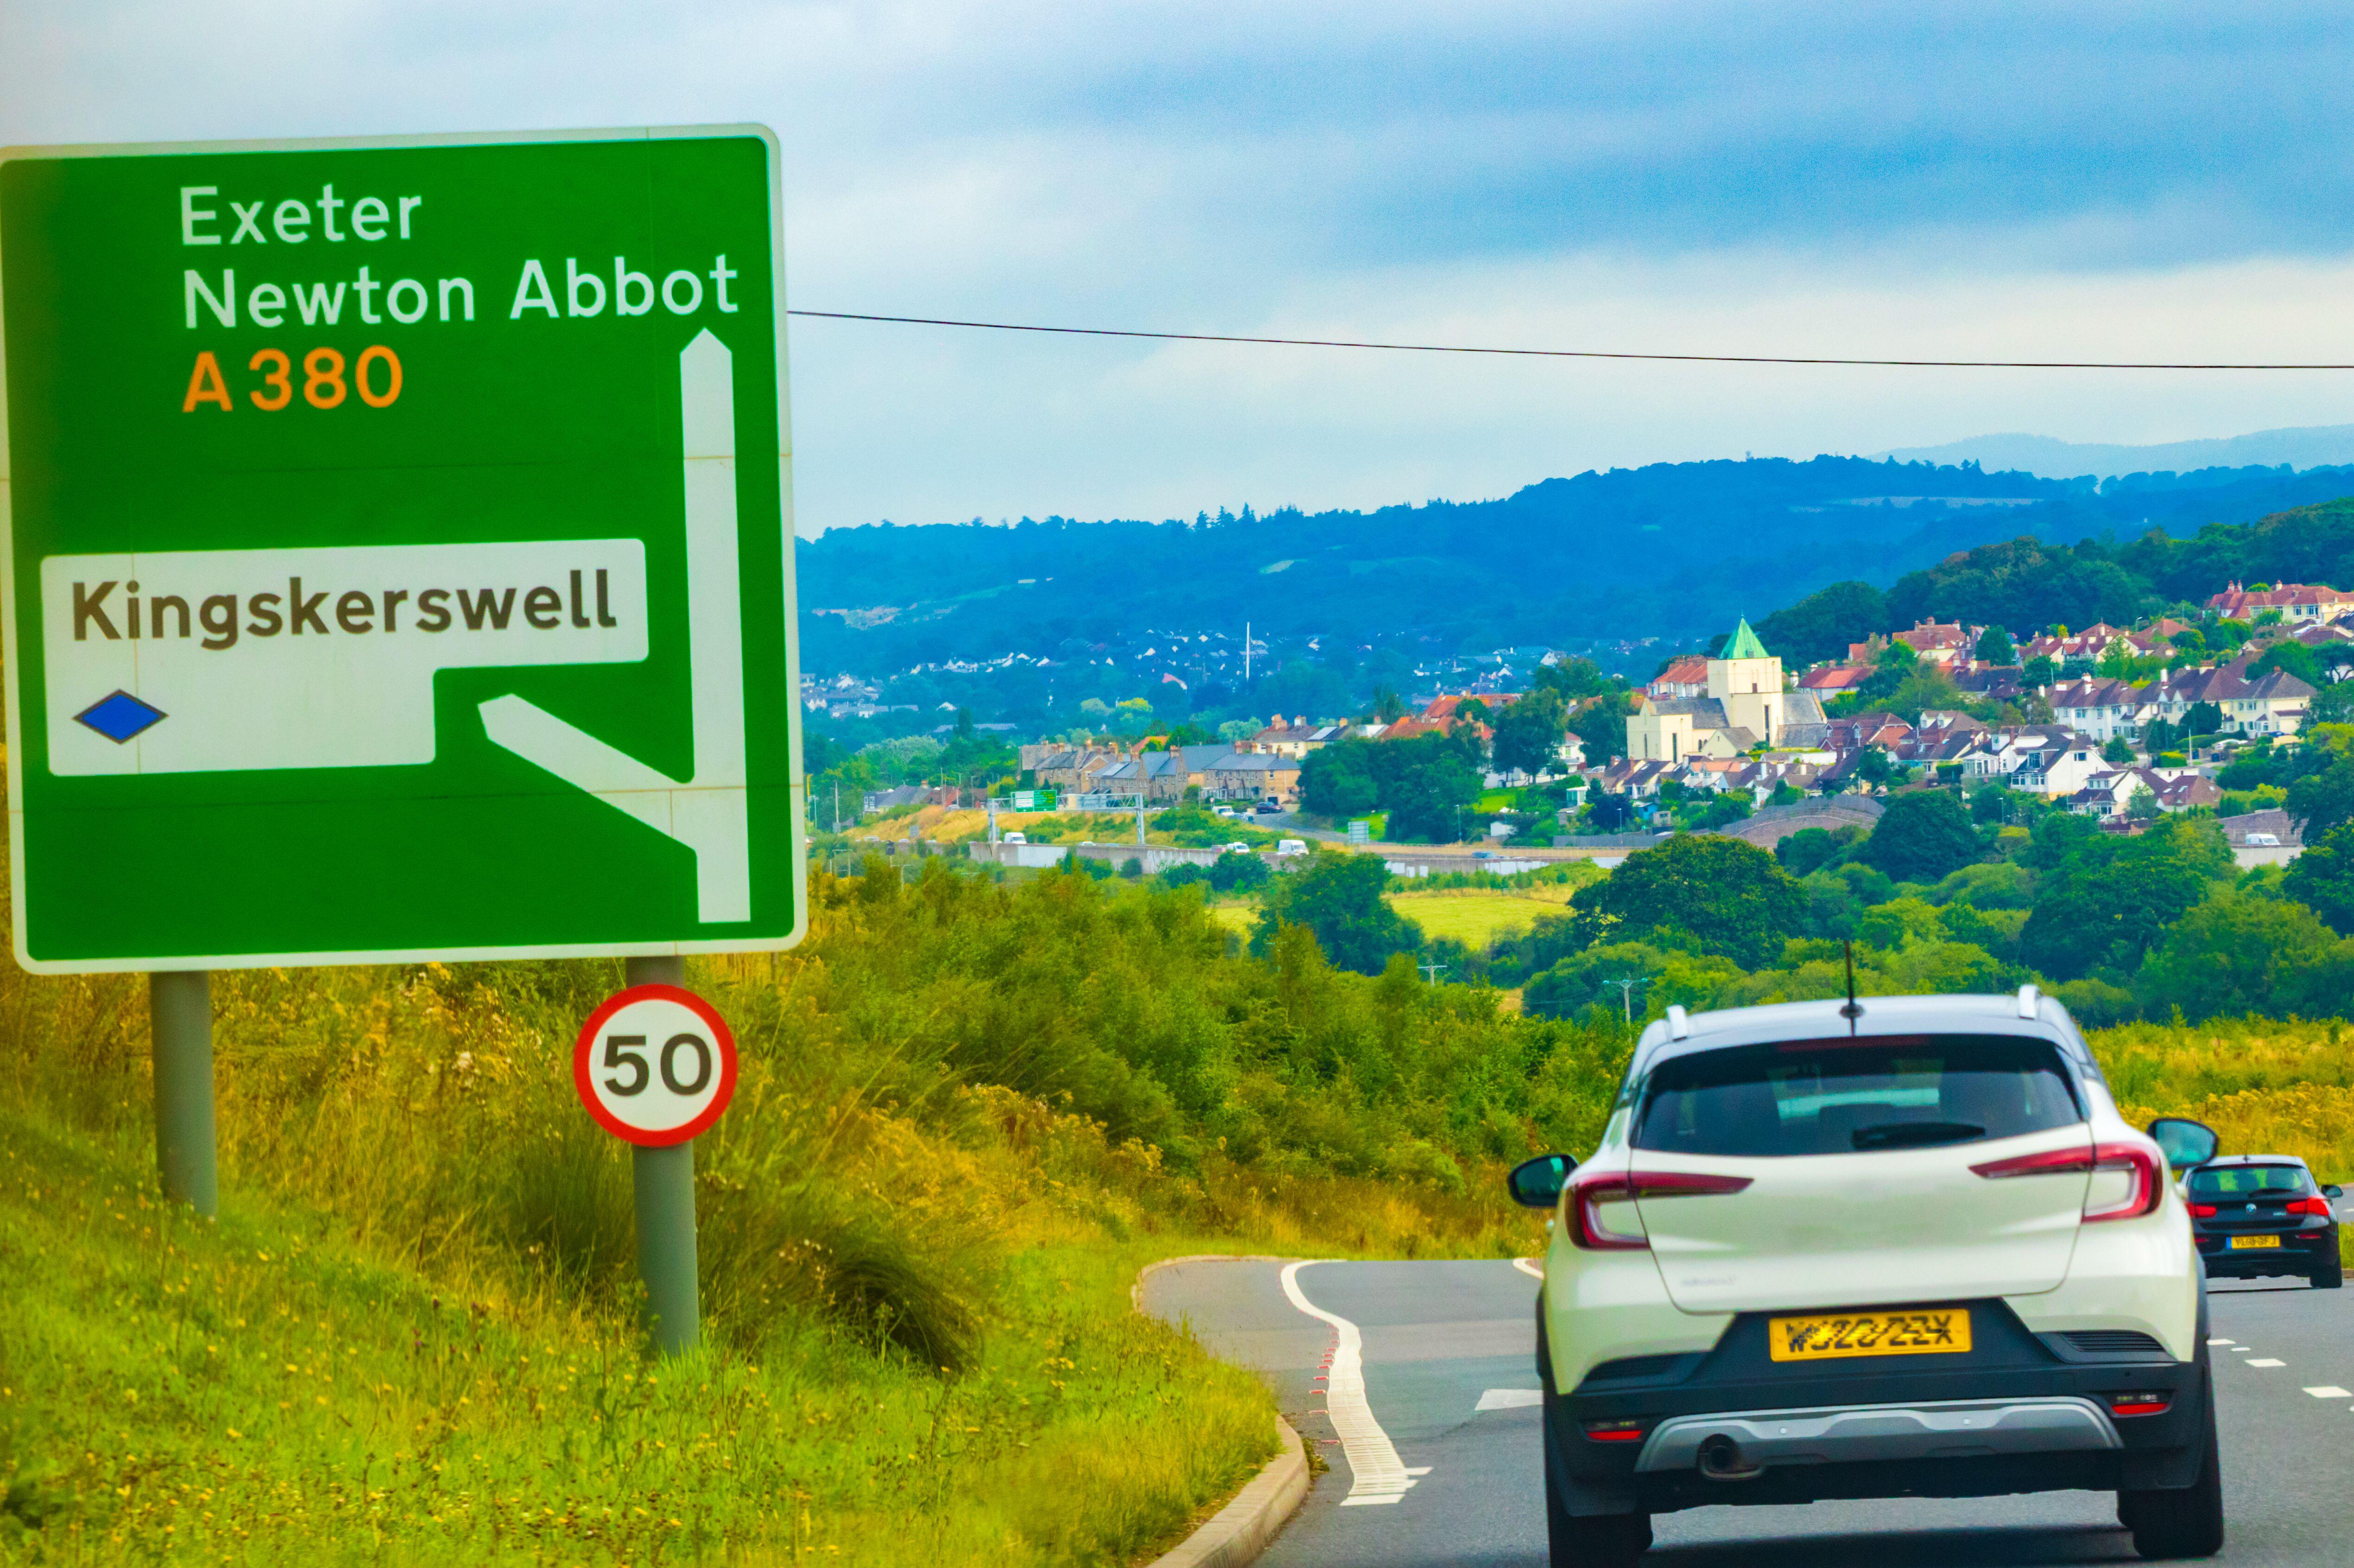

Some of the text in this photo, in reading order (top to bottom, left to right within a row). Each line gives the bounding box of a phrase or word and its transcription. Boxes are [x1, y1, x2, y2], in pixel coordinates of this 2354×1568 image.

[181, 183, 421, 246] Exeter
[184, 253, 739, 329] Newton Abbot
[72, 569, 617, 651] Kingskerswell
[603, 1033, 712, 1097] 50
